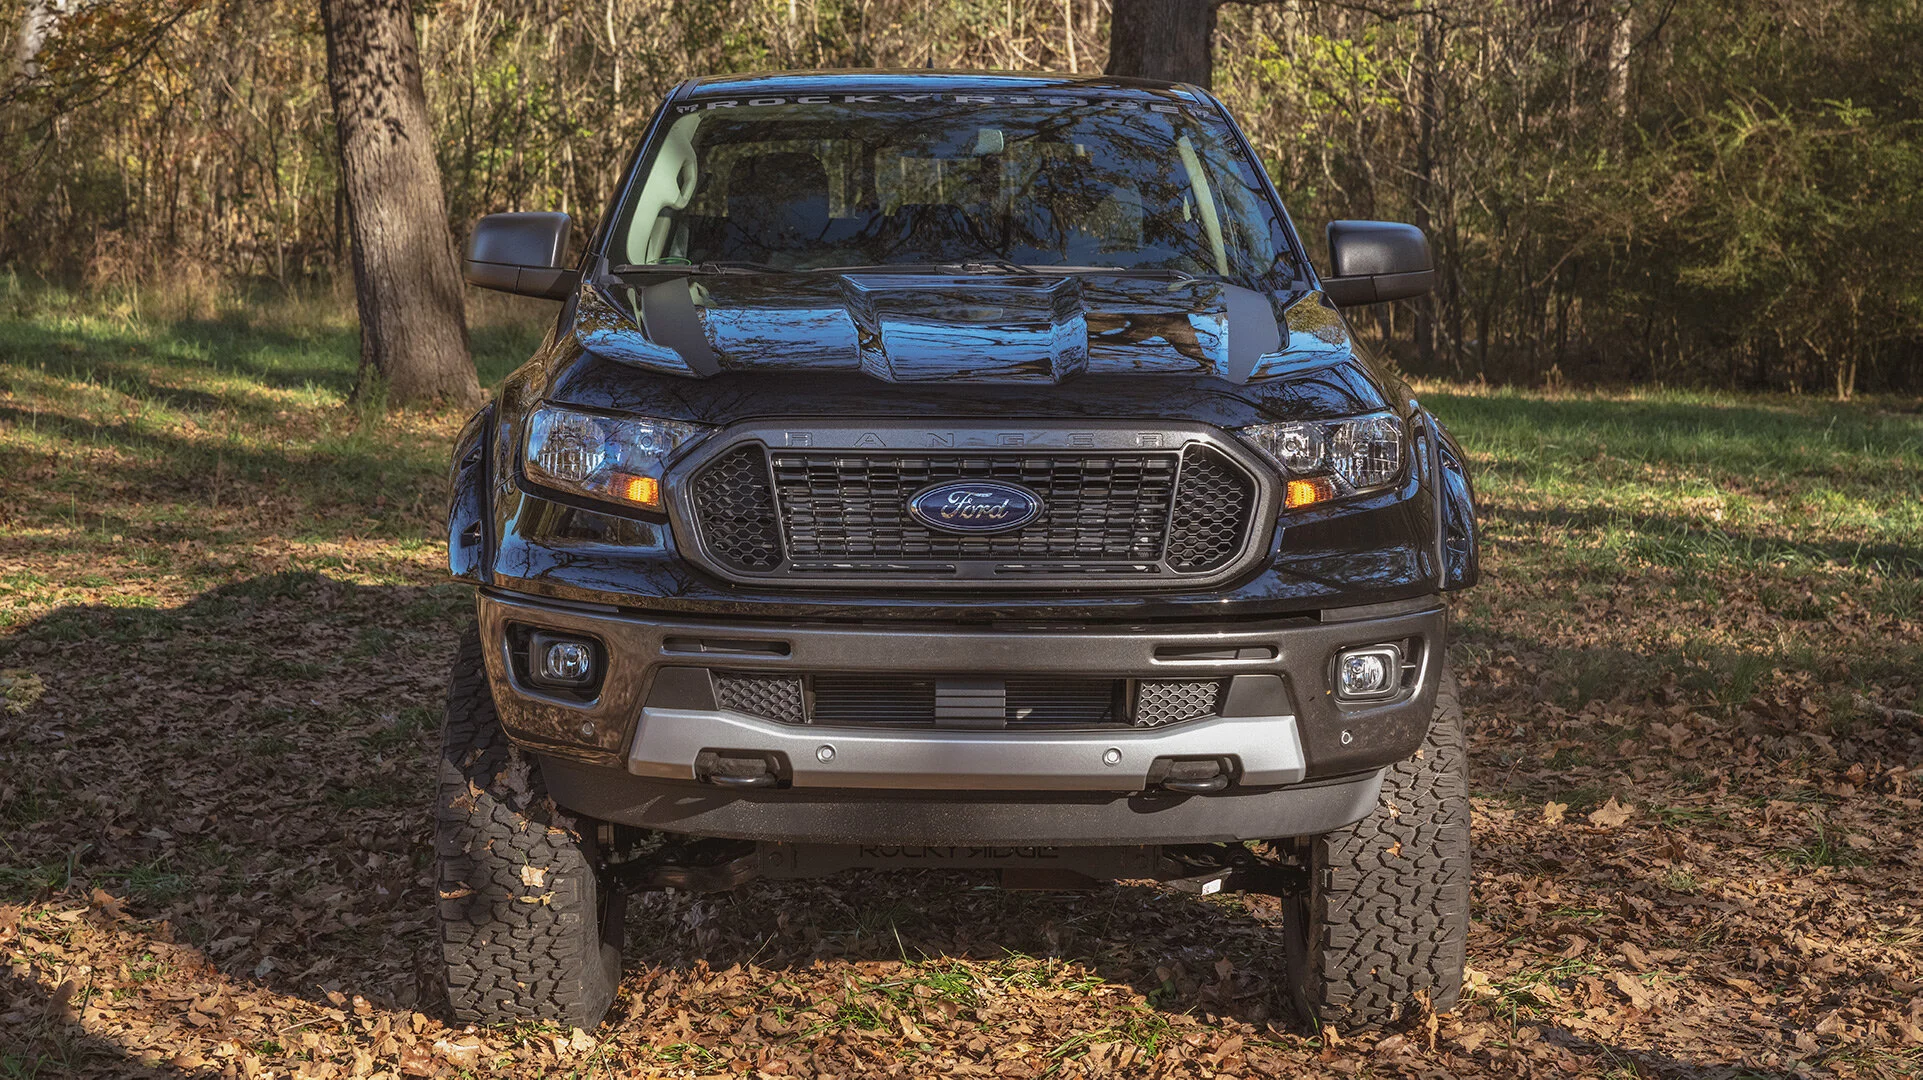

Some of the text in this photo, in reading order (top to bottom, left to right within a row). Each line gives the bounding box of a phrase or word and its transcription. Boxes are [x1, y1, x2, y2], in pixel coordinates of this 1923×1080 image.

[706, 95, 1180, 114] ROCKY RIDGE
[783, 431, 1164, 448] RANGER
[940, 490, 1010, 519] Ford
